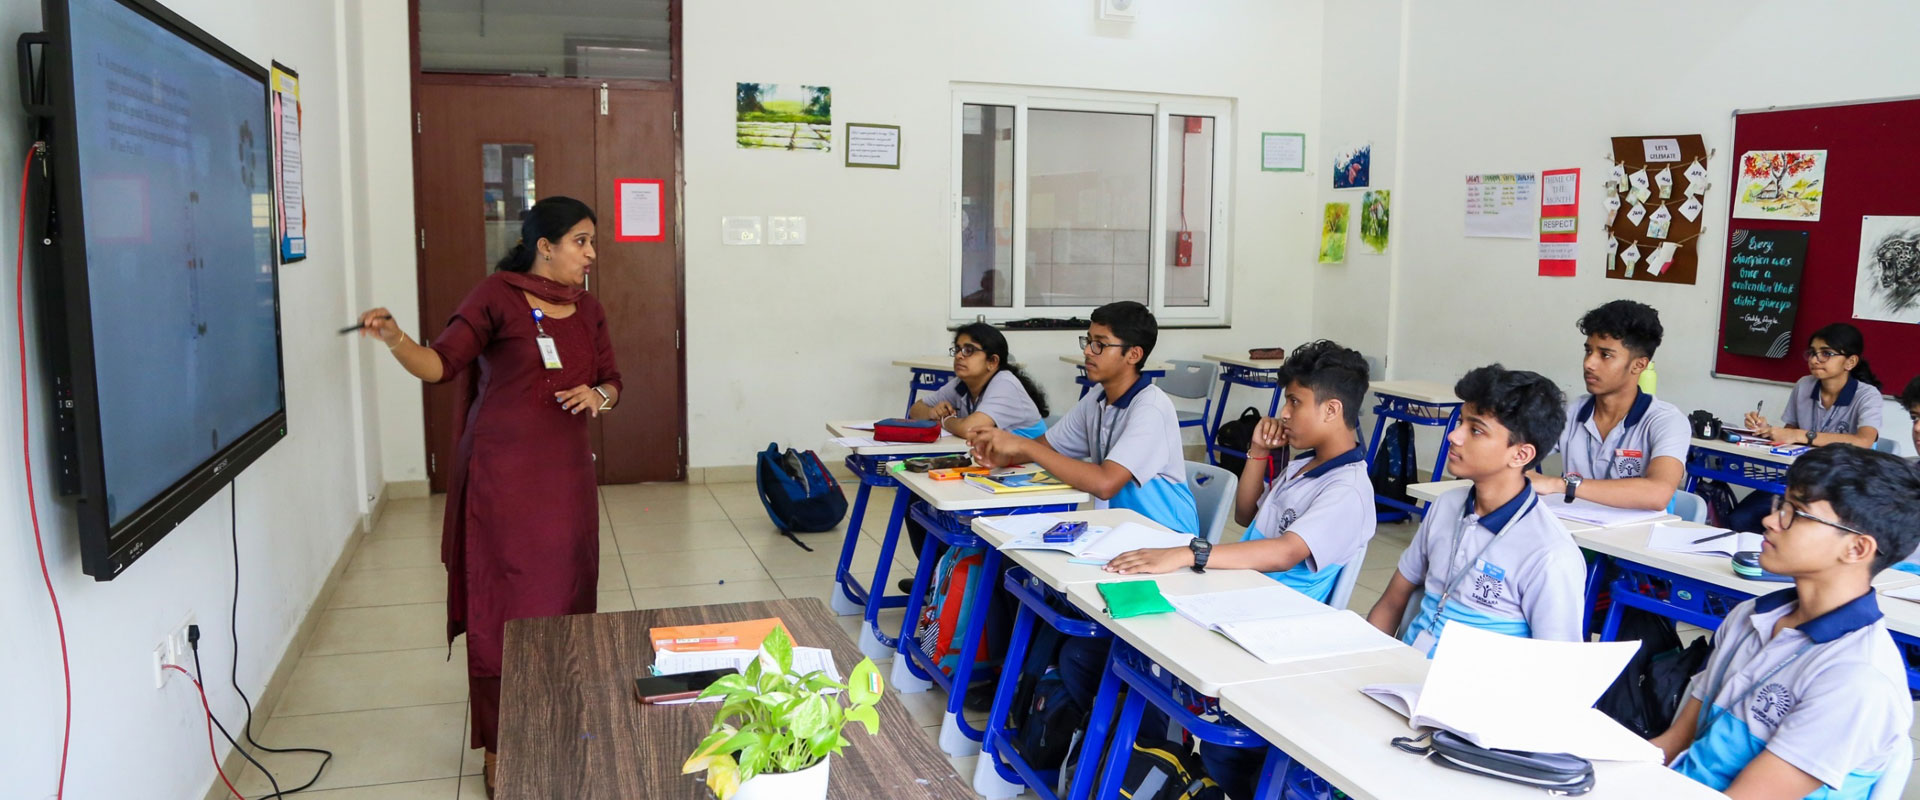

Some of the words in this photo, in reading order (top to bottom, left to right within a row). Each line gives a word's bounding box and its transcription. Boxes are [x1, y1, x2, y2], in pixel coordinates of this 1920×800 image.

[1543, 219, 1573, 229] RESPECT
[1748, 235, 1774, 254] Every
[1771, 256, 1792, 267] was
[1764, 270, 1772, 278] a
